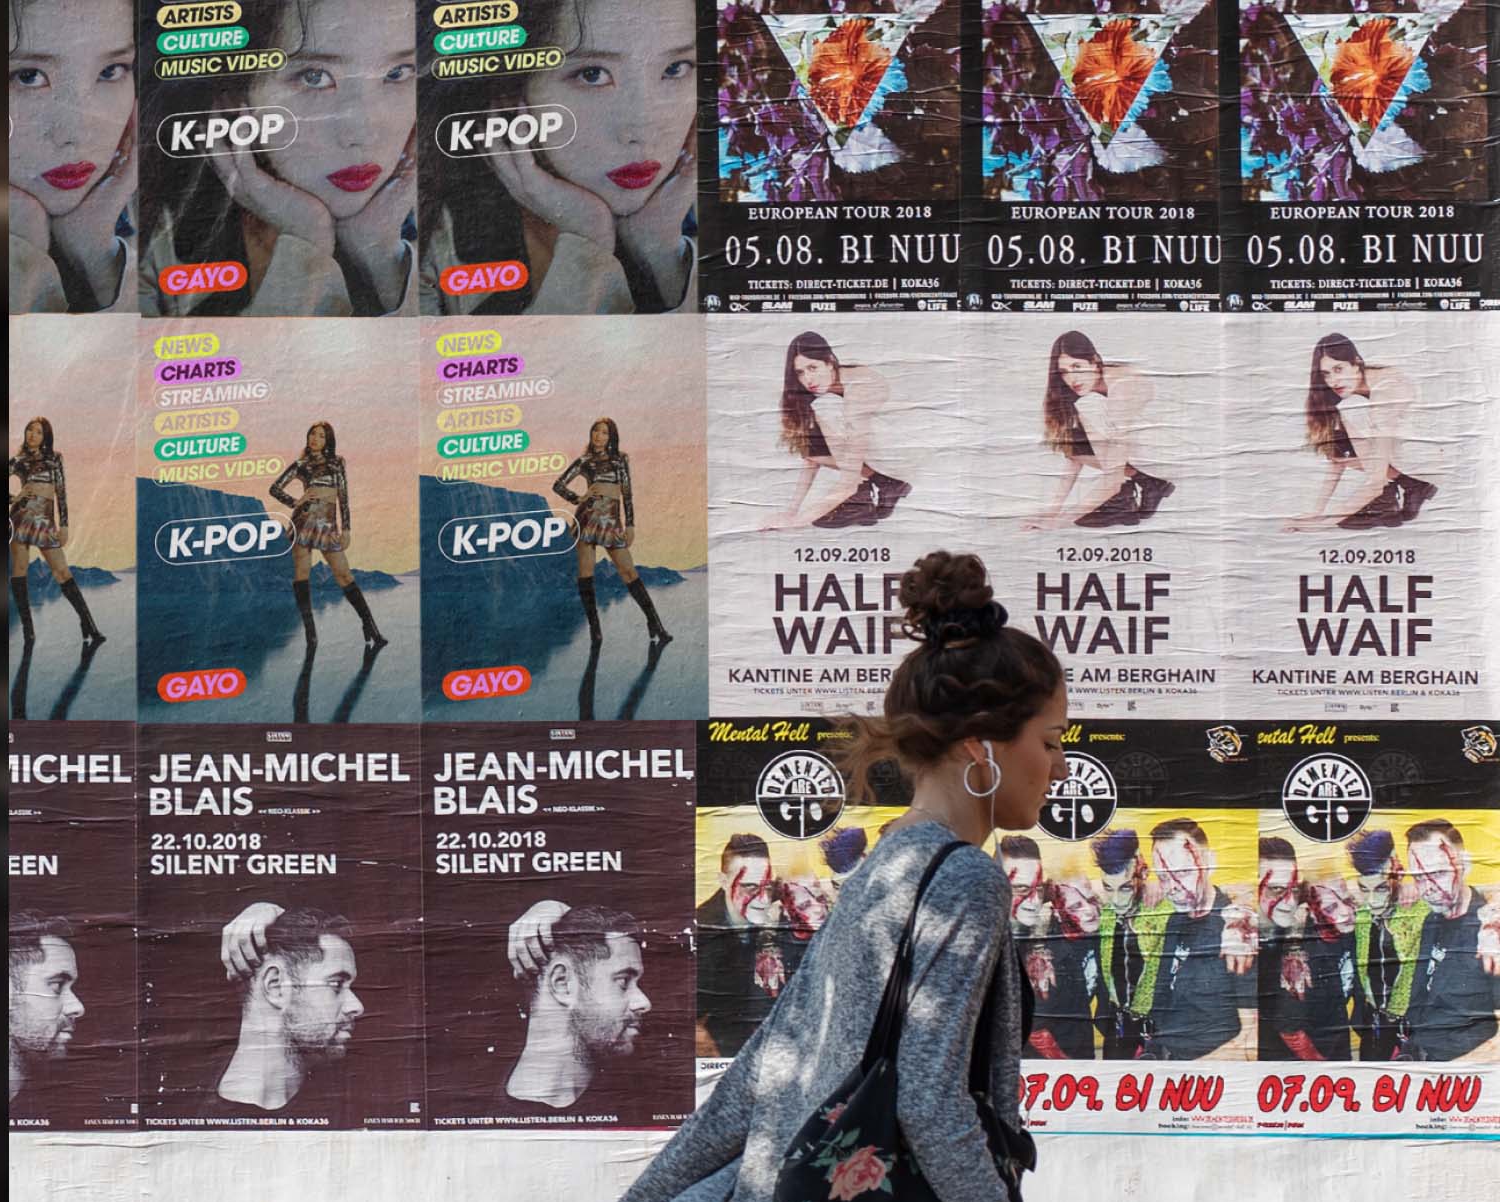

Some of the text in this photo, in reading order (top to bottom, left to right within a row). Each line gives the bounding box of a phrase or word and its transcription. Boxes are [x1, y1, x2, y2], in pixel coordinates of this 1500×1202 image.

[163, 5, 234, 25] ARTISTS
[440, 3, 511, 25] ARTISTS
[163, 30, 243, 50] CULTURE
[440, 28, 520, 50] CULTURE
[161, 52, 284, 76] MUSIC VIDEO
[438, 50, 561, 77] MUSIC VIDEO
[171, 113, 285, 151] K-POP
[450, 112, 564, 151] K-POP
[748, 206, 932, 220] EUROPEAN TOUR 2018
[1011, 207, 1195, 220] EUROPEAN TOUR 2018
[1270, 206, 1455, 220] EUROPEAN TOUR 2018
[725, 234, 961, 268] 05.08. BI NUU
[987, 234, 1221, 268] 05.08. BI NUU
[1247, 233, 1484, 268] 05.08. BI NUU
[167, 265, 239, 291] GAYO
[449, 265, 520, 291] GAYO
[748, 278, 939, 289] TICKETS: DIRECT-TICKET.DE KOKA36
[1010, 278, 1202, 289] TICKETS: DIRECT-TICKET.DE KOKA36
[1270, 278, 1463, 289] TICKETS: DIRECT-TICKET.DE KOKA36
[161, 337, 213, 355] NEWS
[443, 334, 496, 353] NEWS
[160, 360, 236, 381] CHARTS
[443, 357, 519, 379] CHARTS
[160, 382, 269, 406] STREAMING
[443, 379, 550, 404] STREAMING
[160, 412, 231, 432] ARTISTS
[443, 408, 515, 429] ARTISTS
[160, 436, 240, 457] CULTURE
[443, 433, 523, 455] CULTURE
[158, 457, 282, 484] MUSIC VIDEO
[442, 455, 566, 481] MUSIC VIDEO
[168, 519, 283, 558] K-POP
[452, 517, 567, 555] K-POP
[794, 548, 890, 562] 12.09.2018
[1056, 548, 1153, 562] 12.09.2018
[1318, 550, 1415, 564] 12.09.2018
[775, 573, 903, 612] HALF
[1037, 573, 1171, 611] HALF
[1299, 575, 1433, 613] HALF
[773, 617, 905, 654] WAIF
[1034, 616, 1170, 654] WAIF
[1297, 618, 1433, 657] WAIF
[165, 671, 239, 698] GAYO
[450, 669, 524, 696] GAYO
[729, 669, 813, 683] KANTINE
[819, 669, 850, 683] AM
[1080, 669, 1111, 683] AM
[1118, 669, 1216, 683] BERGHAIN
[1252, 670, 1479, 685] KANTINE AM BERGHAIN
[708, 721, 769, 742] Mental
[772, 721, 811, 741] Hell
[1060, 724, 1082, 743] ell
[1257, 727, 1295, 744] ental
[1299, 724, 1337, 744] Hell
[149, 752, 410, 783] JEAN-MICHEL
[433, 749, 694, 782] JEAN-MICHEL
[767, 760, 835, 794] DEMENTED
[791, 778, 813, 794] ARE
[1067, 761, 1108, 796] ENTED
[1293, 762, 1363, 798] DEMENTED
[433, 784, 538, 815] BLAIS
[1063, 781, 1083, 796] ARE
[1317, 782, 1340, 797] ARE
[149, 786, 253, 816] BLAIS
[151, 833, 261, 850] 22.10.2018
[436, 831, 546, 849] 22.10.2018
[151, 854, 337, 875] SILENT GREEN
[436, 851, 622, 874] SILENT GREEN
[1116, 1073, 1154, 1112] BI
[1159, 1073, 1224, 1112] NUU
[1257, 1073, 1482, 1113] 07.09. BI NUU
[586, 1115, 618, 1123] KOKA36
